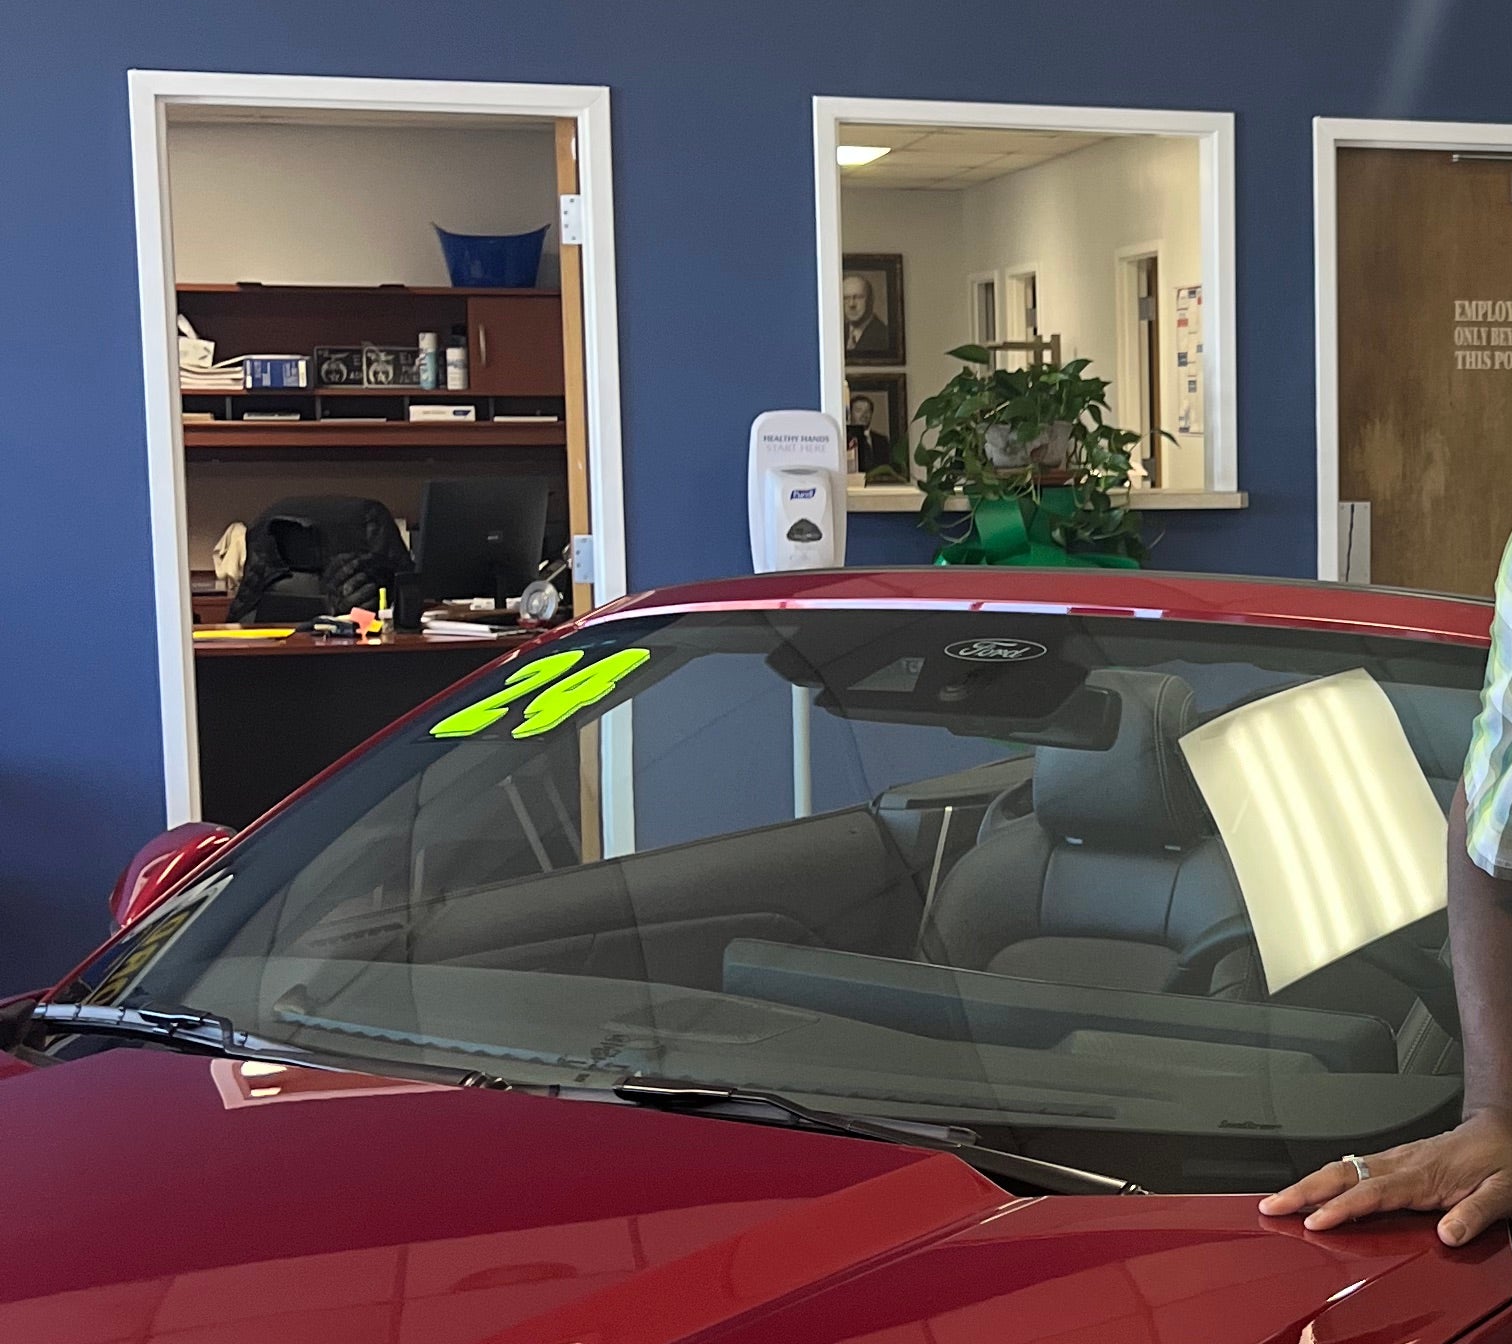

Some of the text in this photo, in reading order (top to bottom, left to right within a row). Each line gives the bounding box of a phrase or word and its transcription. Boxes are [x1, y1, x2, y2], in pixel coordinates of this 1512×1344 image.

[1454, 327, 1488, 346] ONLY
[1455, 351, 1492, 370] THIS
[763, 435, 830, 443] HEALTHY HANDS
[958, 640, 1031, 659] Ford
[428, 647, 651, 739] 24
